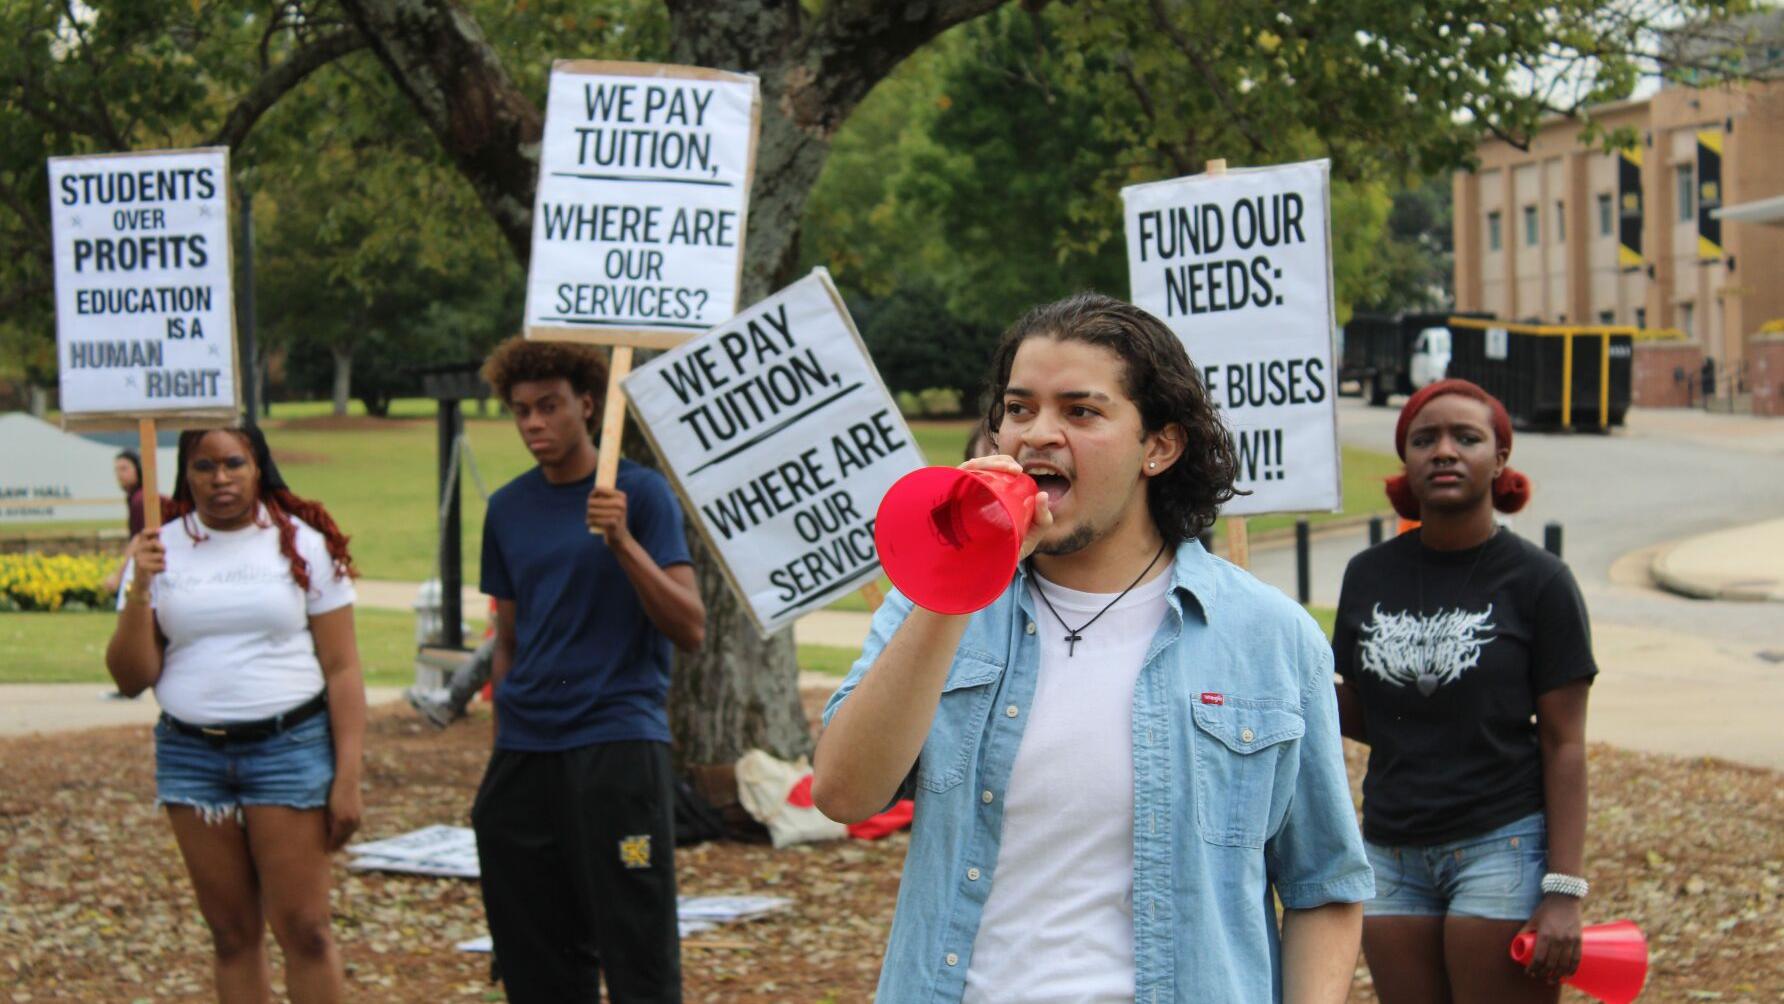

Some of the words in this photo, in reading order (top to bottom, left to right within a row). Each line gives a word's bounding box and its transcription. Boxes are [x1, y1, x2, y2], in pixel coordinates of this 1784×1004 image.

[585, 83, 637, 122] WE
[644, 86, 713, 126] PAY
[574, 127, 719, 178] TUITION,
[61, 168, 216, 206] STUDENTS
[113, 208, 166, 231] OVER
[543, 203, 662, 243] WHERE
[668, 207, 737, 247] ARE
[1138, 202, 1225, 262] FUND
[1232, 191, 1306, 250] OUR
[73, 234, 208, 272] PROFITS
[605, 248, 664, 281] OUR
[76, 286, 212, 314] EDUCATION
[555, 283, 709, 320] SERVICES?
[1164, 255, 1283, 317] NEEDS:
[167, 318, 184, 339] IS
[190, 317, 204, 339] A
[69, 340, 163, 368] HUMAN
[659, 344, 730, 406] WE
[718, 303, 797, 376] PAY
[145, 369, 220, 398] RIGHT
[678, 348, 842, 452] TUITION,
[1227, 357, 1326, 409] BUSES
[702, 447, 836, 541] WHERE
[830, 409, 907, 479] ARE
[793, 490, 861, 543] OUR
[768, 518, 876, 602] SERVIC
